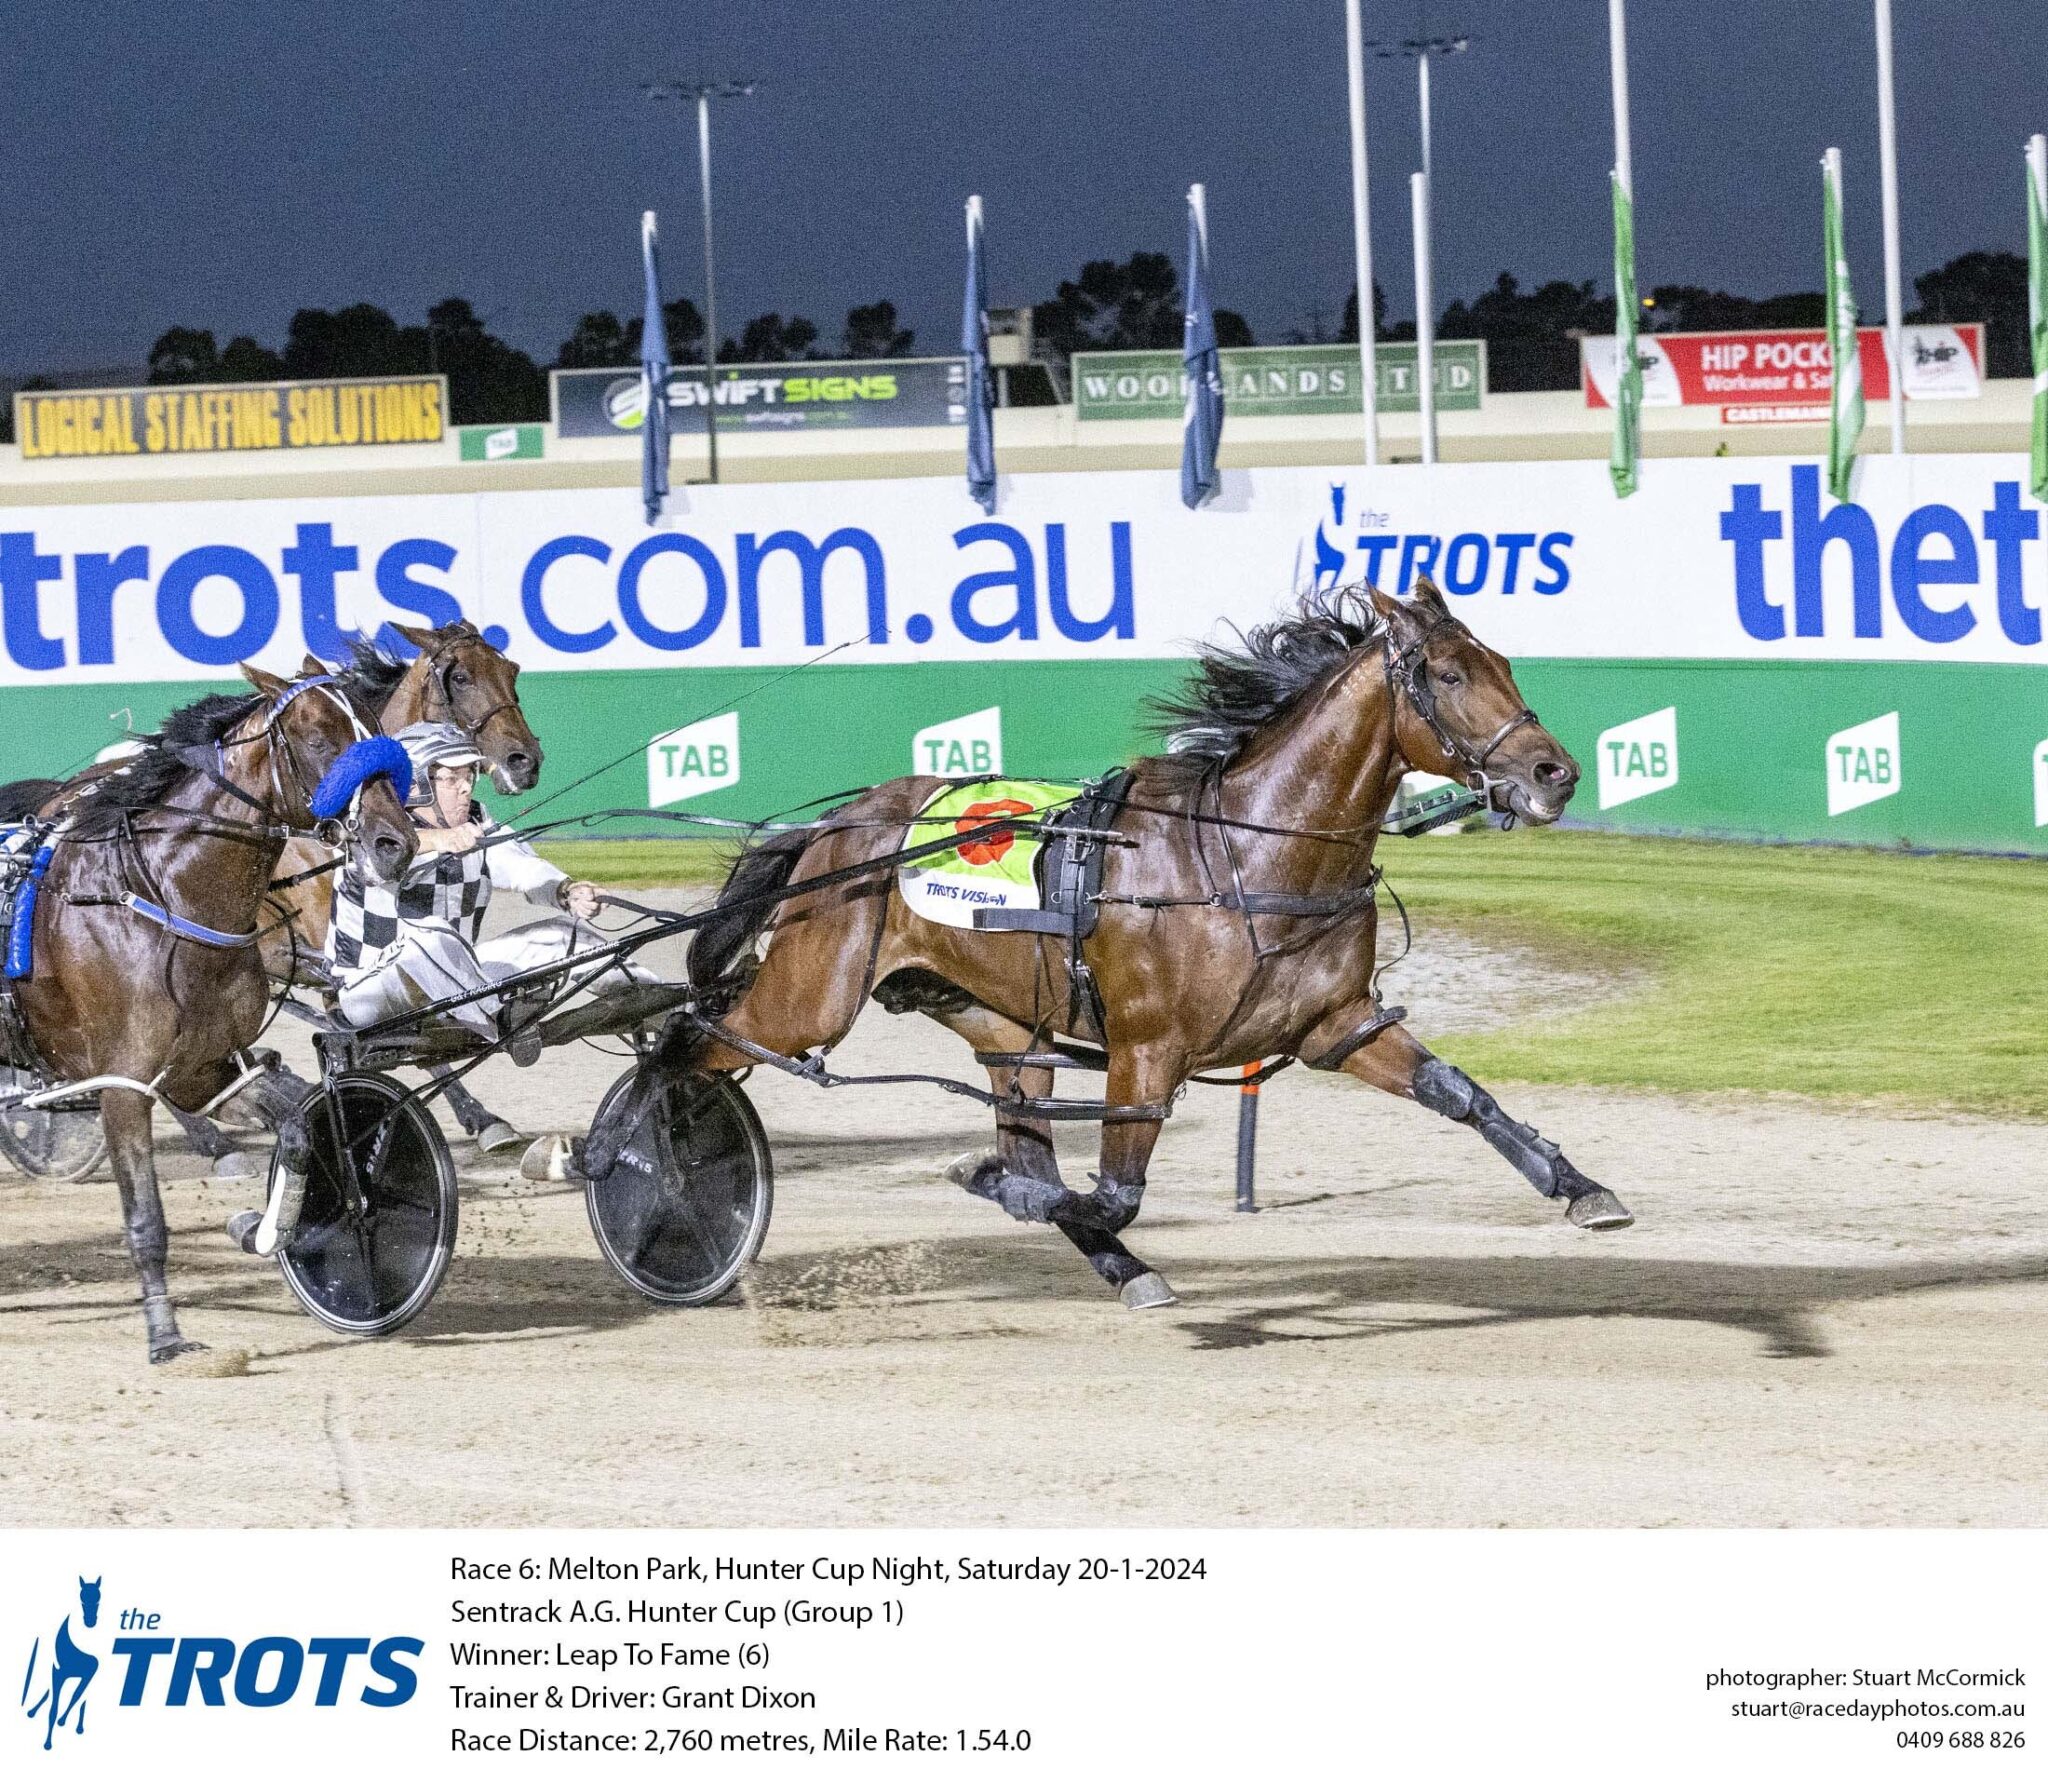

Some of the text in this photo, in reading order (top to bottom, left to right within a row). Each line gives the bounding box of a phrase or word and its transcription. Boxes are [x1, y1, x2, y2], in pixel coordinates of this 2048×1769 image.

[1702, 341, 1836, 370] HIP POCK
[1084, 368, 1347, 399] WOOANDS
[23, 384, 441, 457] LOGICAL STAFFING SOLUTIONS
[1360, 508, 1390, 528] the
[1356, 531, 1575, 596] TROTS
[658, 744, 730, 779] TAB
[923, 739, 993, 774] TAB
[1606, 740, 1669, 779] TAB
[1834, 744, 1891, 785] TAB
